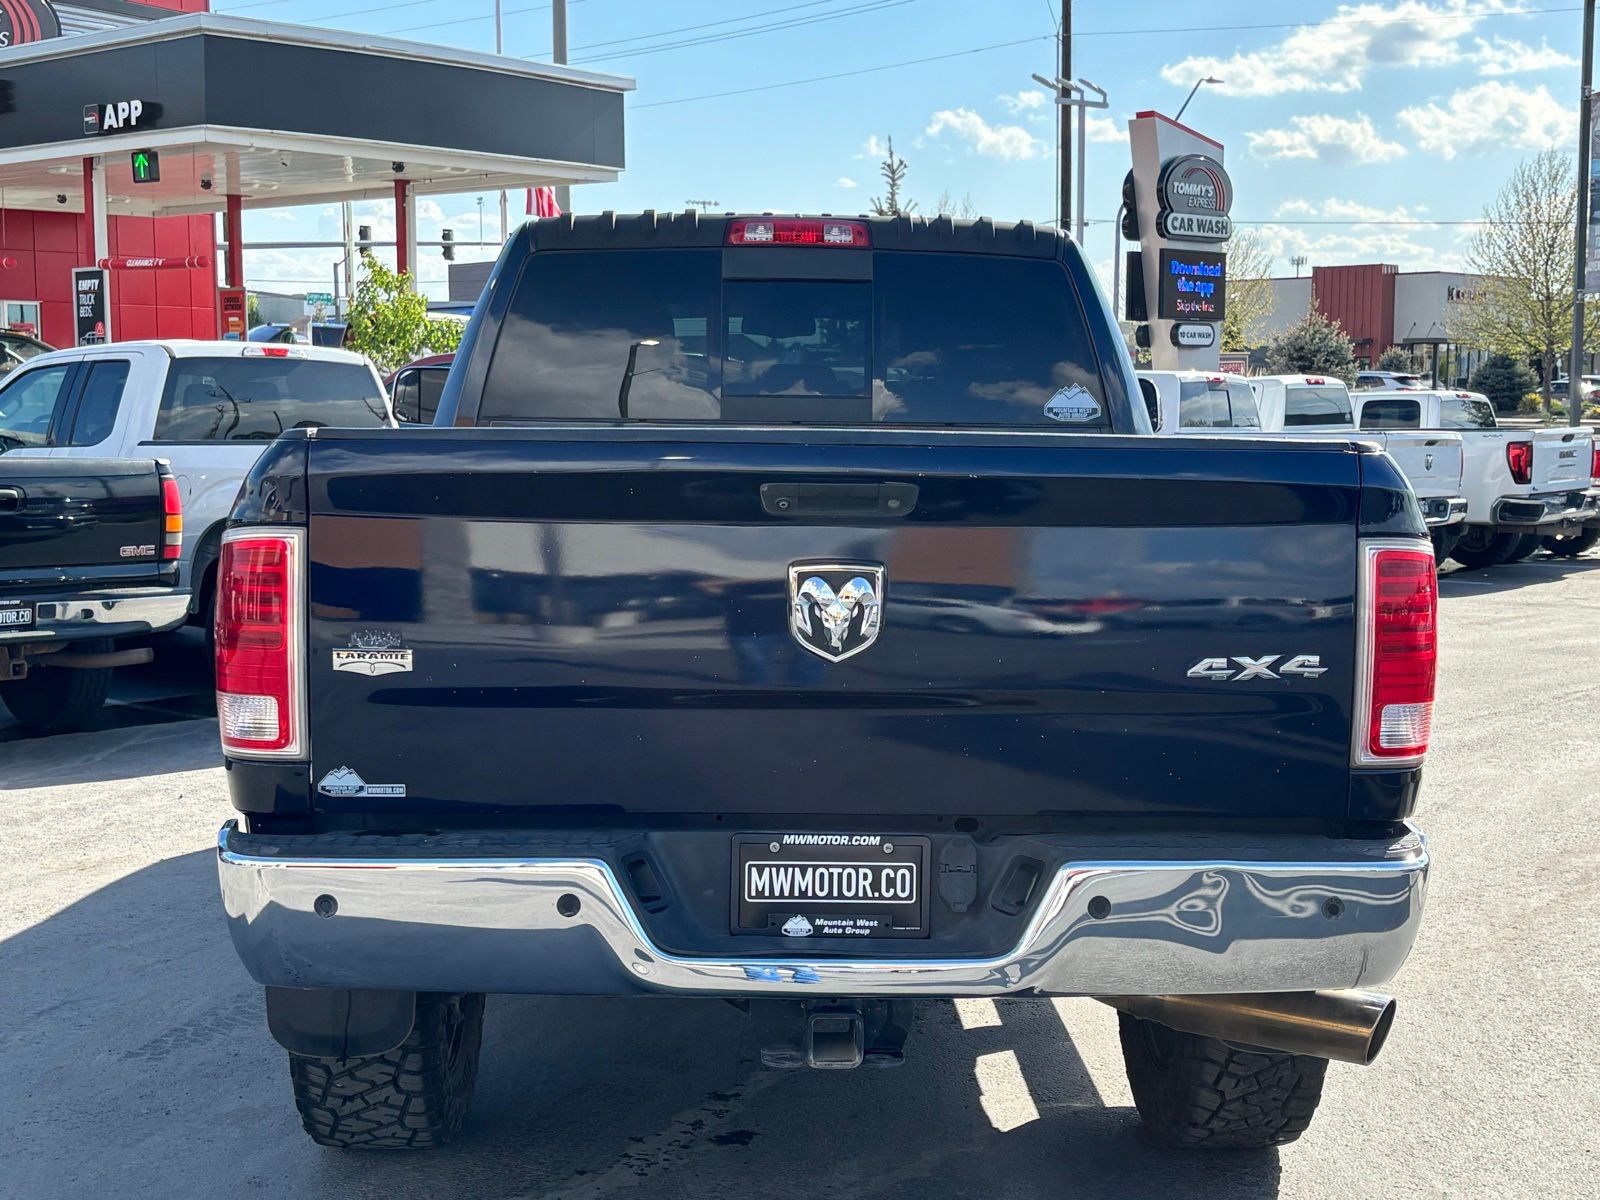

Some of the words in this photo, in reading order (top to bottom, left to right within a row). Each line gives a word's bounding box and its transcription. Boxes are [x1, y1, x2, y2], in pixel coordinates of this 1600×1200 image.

[103, 100, 143, 130] APP
[1173, 181, 1214, 197] TOMMY'S
[1188, 196, 1216, 209] EXPRESS
[1171, 216, 1194, 232] CAR
[1197, 218, 1228, 235] WASH
[1170, 259, 1222, 277] Download
[78, 279, 99, 291] EMPTY
[1177, 276, 1194, 292] the
[1195, 280, 1215, 298] app
[79, 293, 95, 305] TRUCK
[80, 306, 93, 318] BEDS.
[120, 545, 155, 557] GMC
[336, 652, 408, 660] LARAMIE
[782, 834, 881, 846] MWMOTOR.COM
[750, 867, 911, 898] MWMOTOR.CO
[815, 918, 854, 927] Mountain
[856, 919, 878, 927] West
[822, 927, 842, 935] Auto
[844, 927, 871, 936] Group
